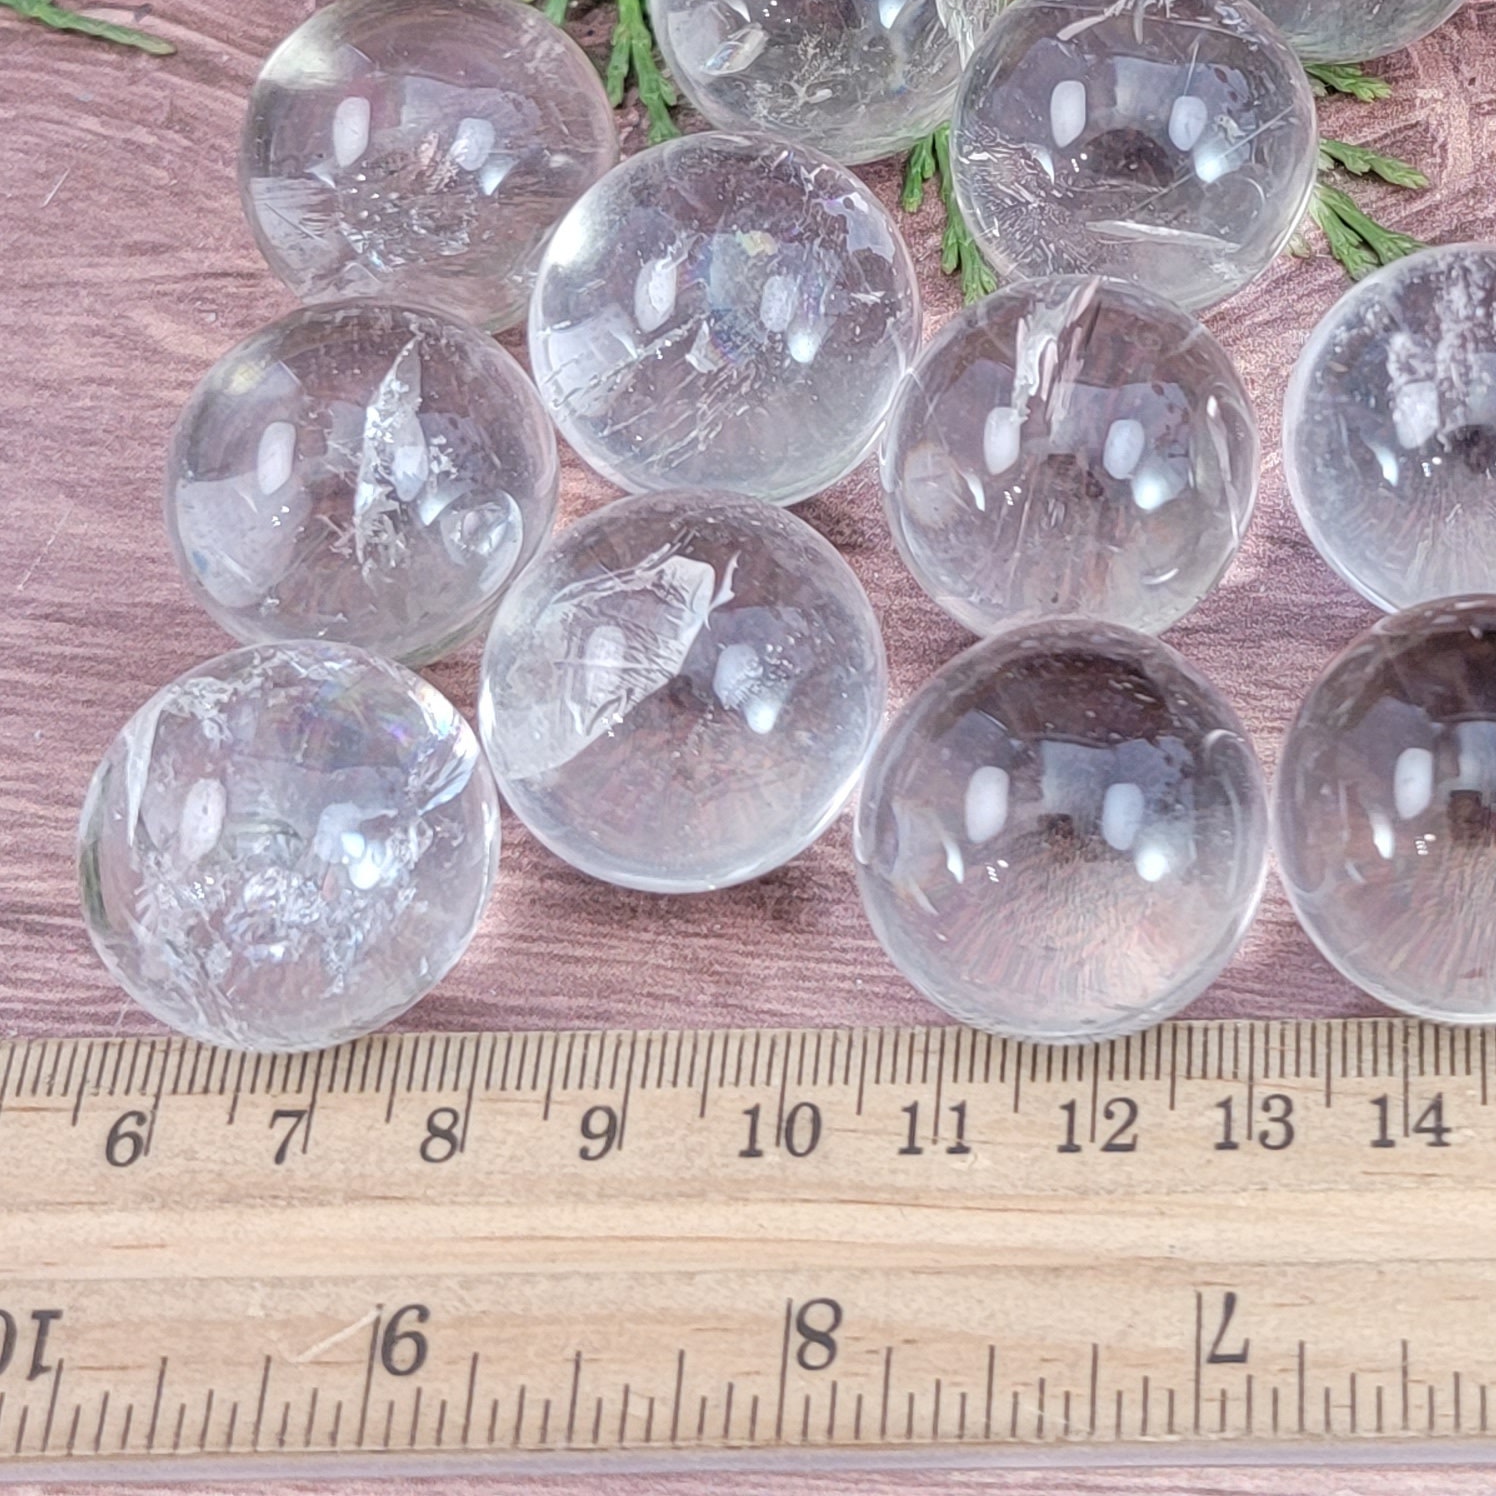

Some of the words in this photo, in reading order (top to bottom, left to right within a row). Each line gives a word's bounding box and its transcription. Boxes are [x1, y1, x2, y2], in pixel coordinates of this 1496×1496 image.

[103, 1109, 149, 1166] 6
[268, 1109, 307, 1165] 7
[418, 1107, 460, 1163] 8
[577, 1105, 619, 1160] 9
[738, 1101, 822, 1158] 10
[898, 1100, 972, 1154] 11
[1058, 1097, 1139, 1153] 12
[1214, 1094, 1296, 1150] 13
[1369, 1092, 1452, 1148] 14
[380, 1304, 431, 1376] 9
[794, 1297, 843, 1371] 8
[1205, 1291, 1251, 1364] 7
